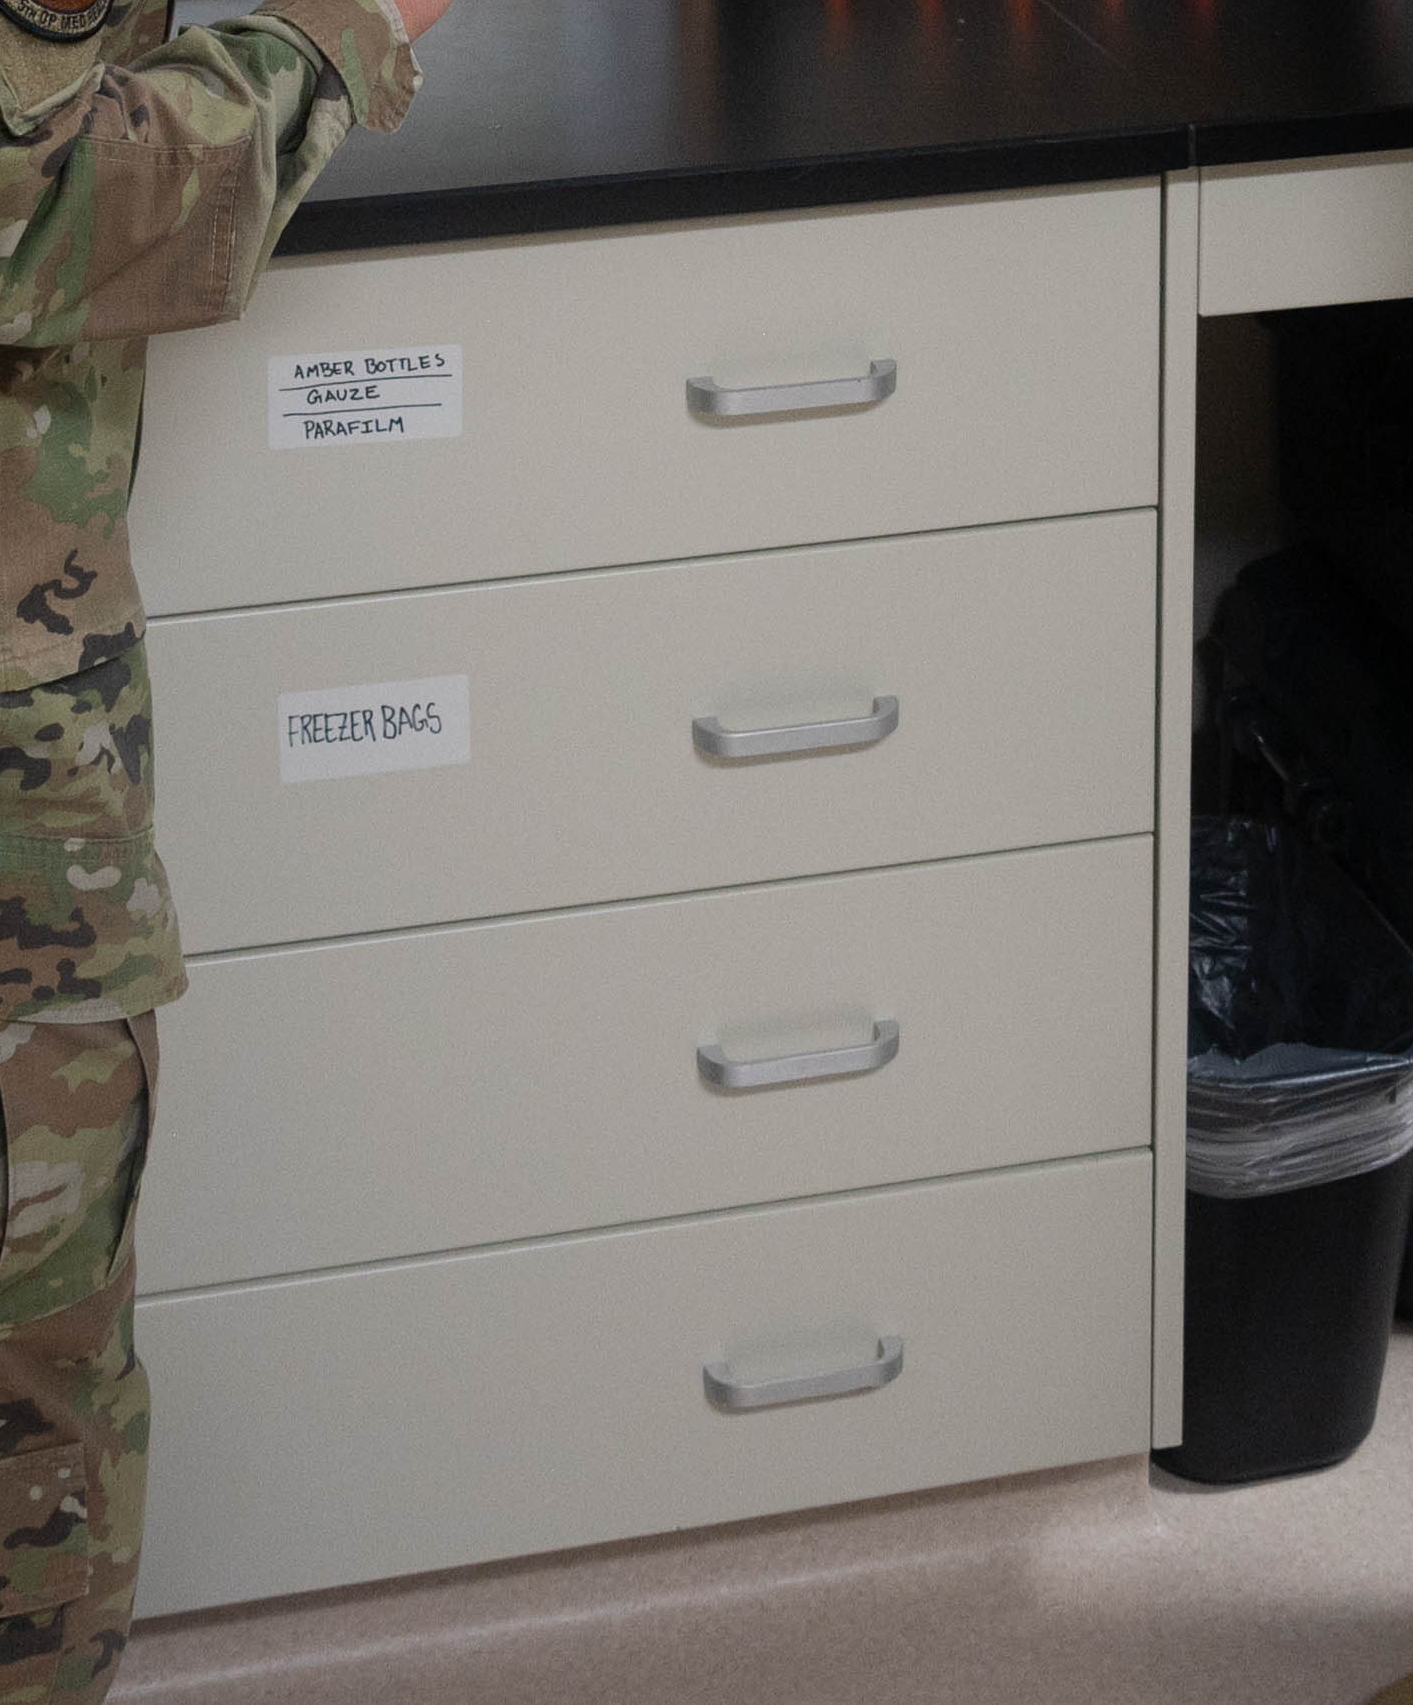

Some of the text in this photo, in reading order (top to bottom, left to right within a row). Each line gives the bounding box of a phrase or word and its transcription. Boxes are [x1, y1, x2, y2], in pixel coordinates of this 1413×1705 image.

[39, 14, 57, 26] OP
[61, 15, 88, 30] MED
[294, 353, 445, 380] AMBER BOTTLES
[307, 385, 380, 405] GAUZE
[304, 416, 405, 439] PARAFILM
[288, 702, 442, 747] FREEZER BAGS
